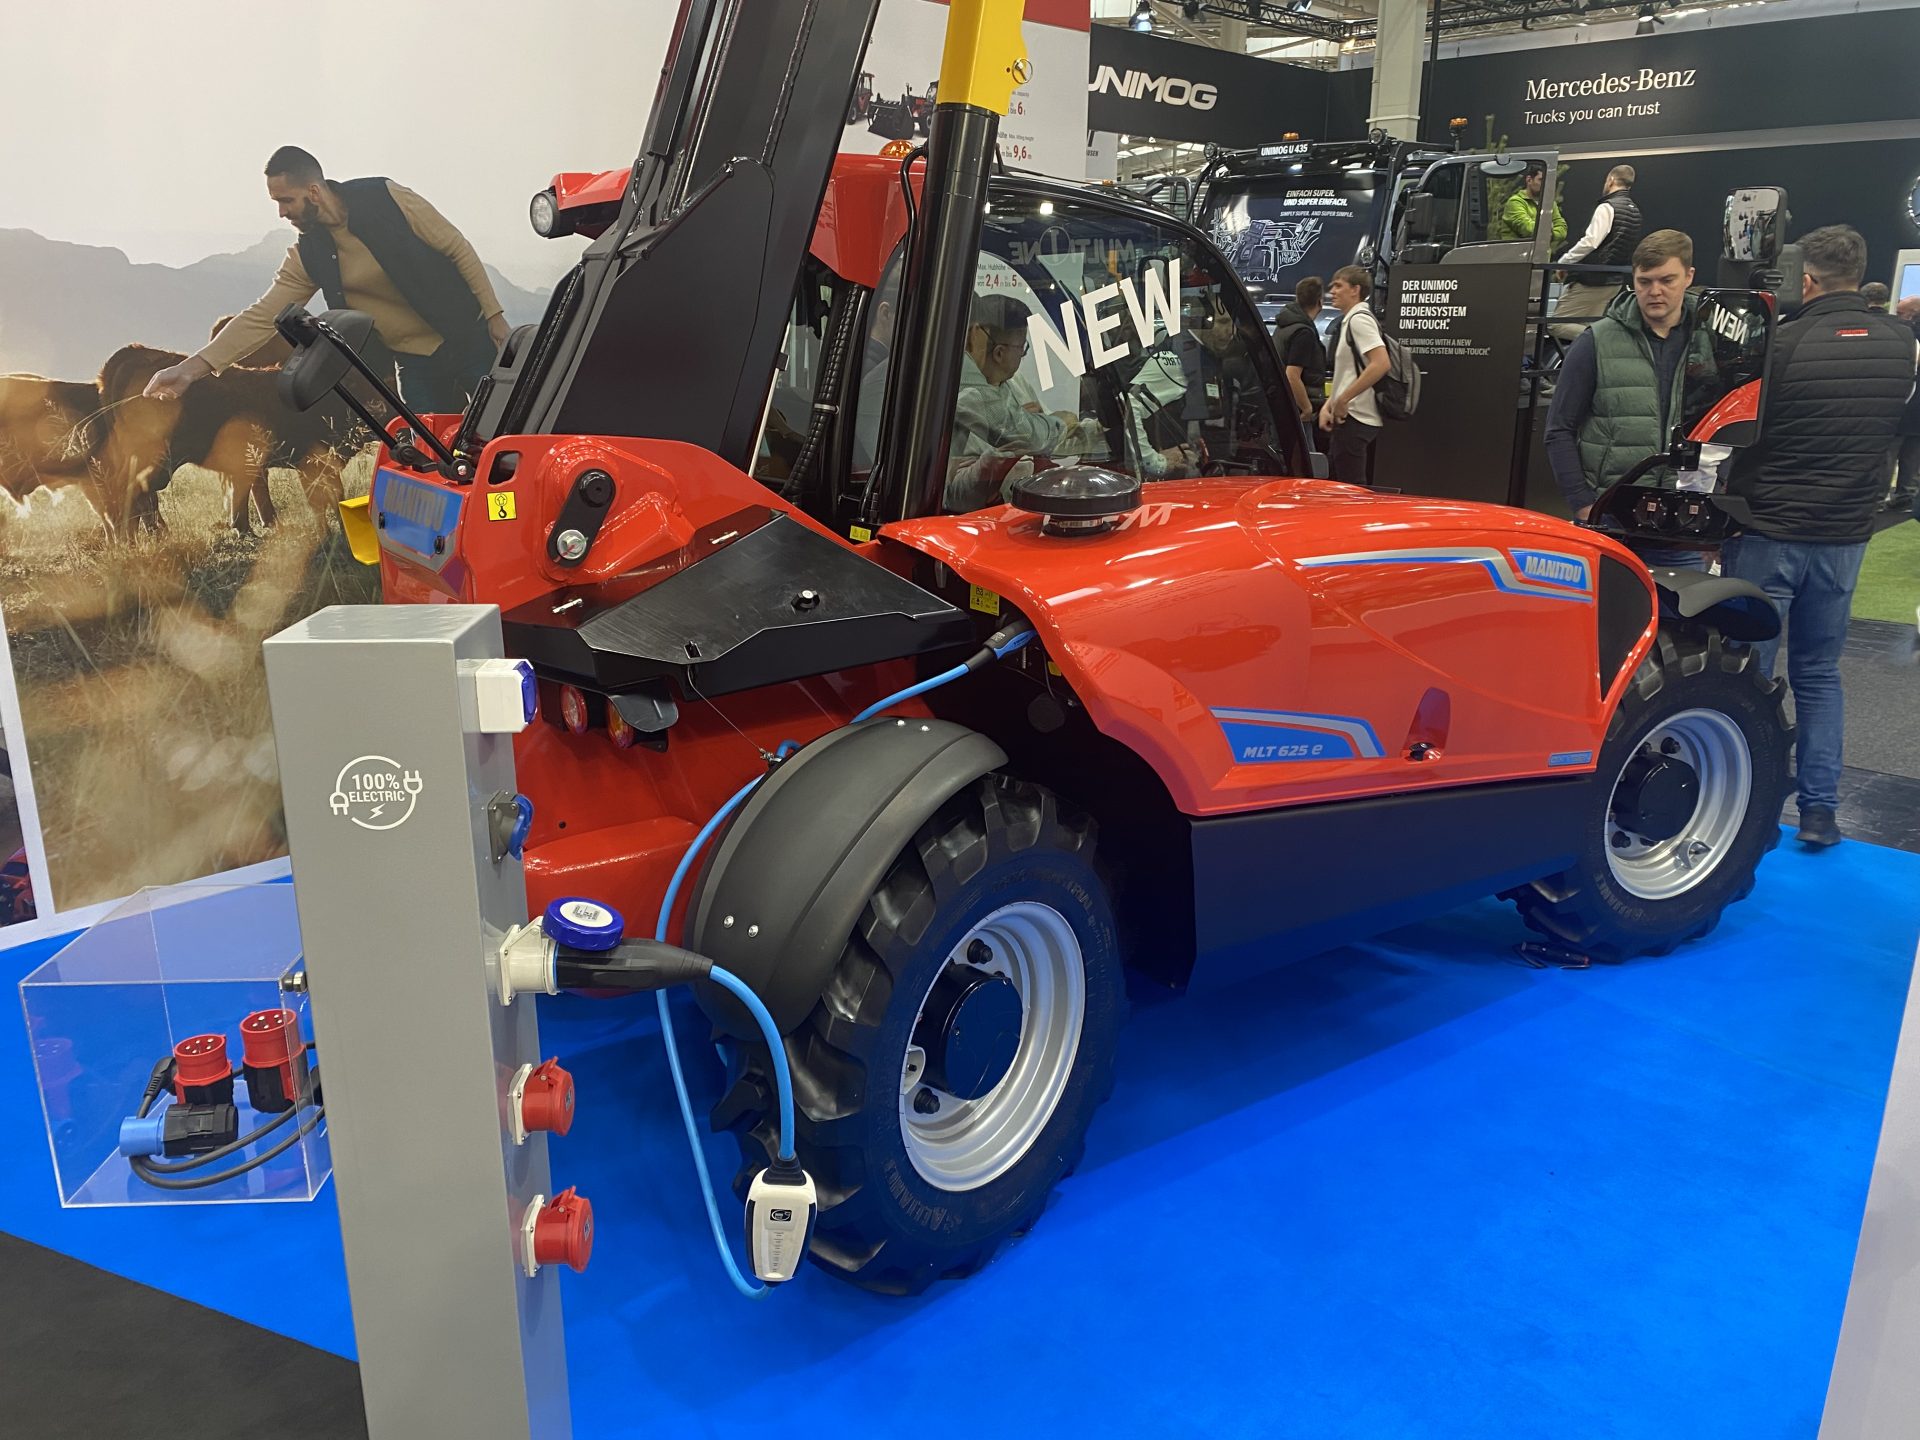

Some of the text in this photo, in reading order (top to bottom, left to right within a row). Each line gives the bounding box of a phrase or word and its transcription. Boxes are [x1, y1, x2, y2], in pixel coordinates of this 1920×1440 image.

[1525, 68, 1697, 101] Mercedes-Benz
[1017, 101, 1023, 115] 6
[1524, 101, 1661, 125] Trucks you can trust
[1013, 144, 1027, 161] 9,6
[1261, 144, 1308, 156] UNIMOG U 435
[1283, 198, 1297, 206] UND
[1297, 198, 1319, 206] SUPER
[985, 273, 1000, 289] 2,4
[1012, 274, 1018, 287] 5
[1402, 280, 1458, 291] DER UNIMOG
[1401, 293, 1450, 304] MIT NEUEM
[1400, 306, 1467, 317] BEDIENSYSTEM
[1026, 257, 1181, 392] NEW
[1410, 338, 1434, 346] UNIMOG
[1434, 338, 1451, 346] WITH
[1430, 347, 1454, 355] SYSTEM
[383, 477, 448, 532] MANITOU
[1525, 555, 1583, 583] MANITOU
[1243, 744, 1323, 758] MLT 625 e
[351, 773, 400, 790] 100%
[348, 790, 405, 803] ELECTRIC
